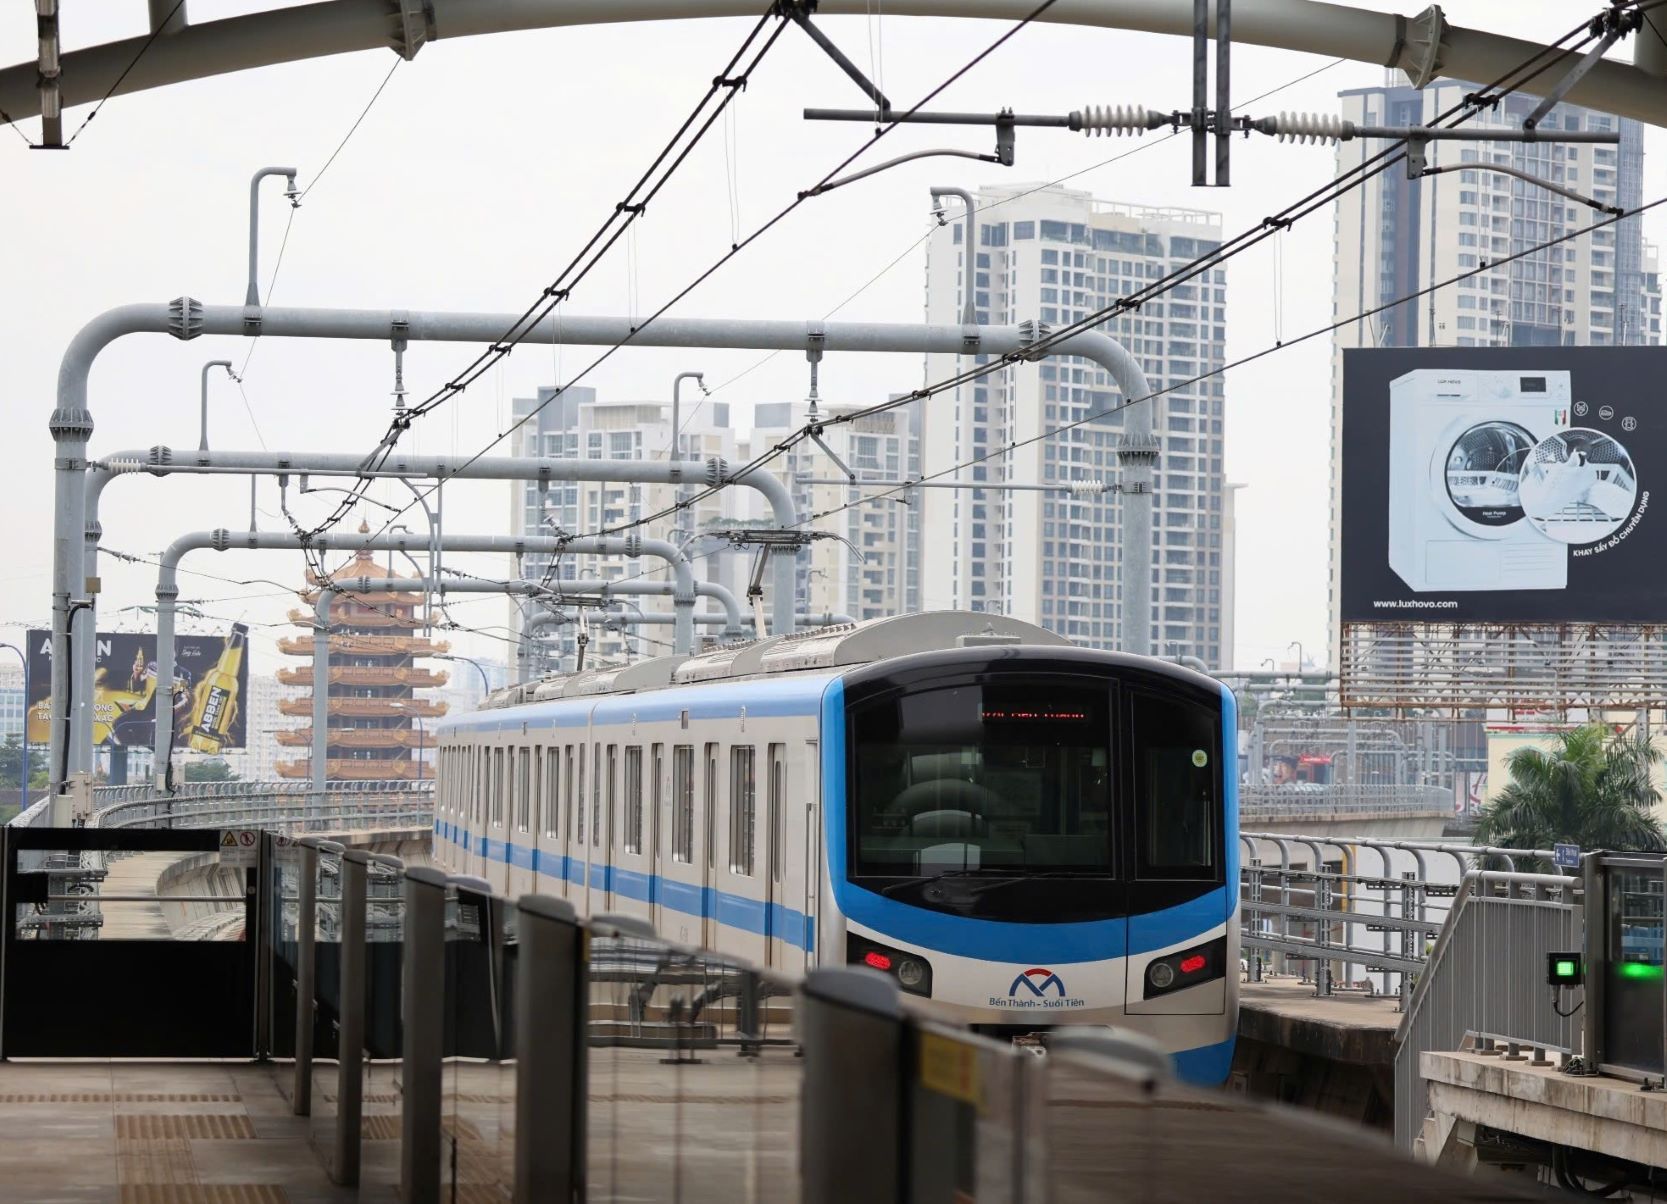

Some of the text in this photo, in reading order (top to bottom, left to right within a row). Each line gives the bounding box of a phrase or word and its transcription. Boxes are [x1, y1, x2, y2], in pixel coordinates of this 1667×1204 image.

[1573, 548, 1593, 557] KHAY
[1373, 599, 1458, 608] www.luxhovo.com
[201, 686, 222, 733] ABBEN
